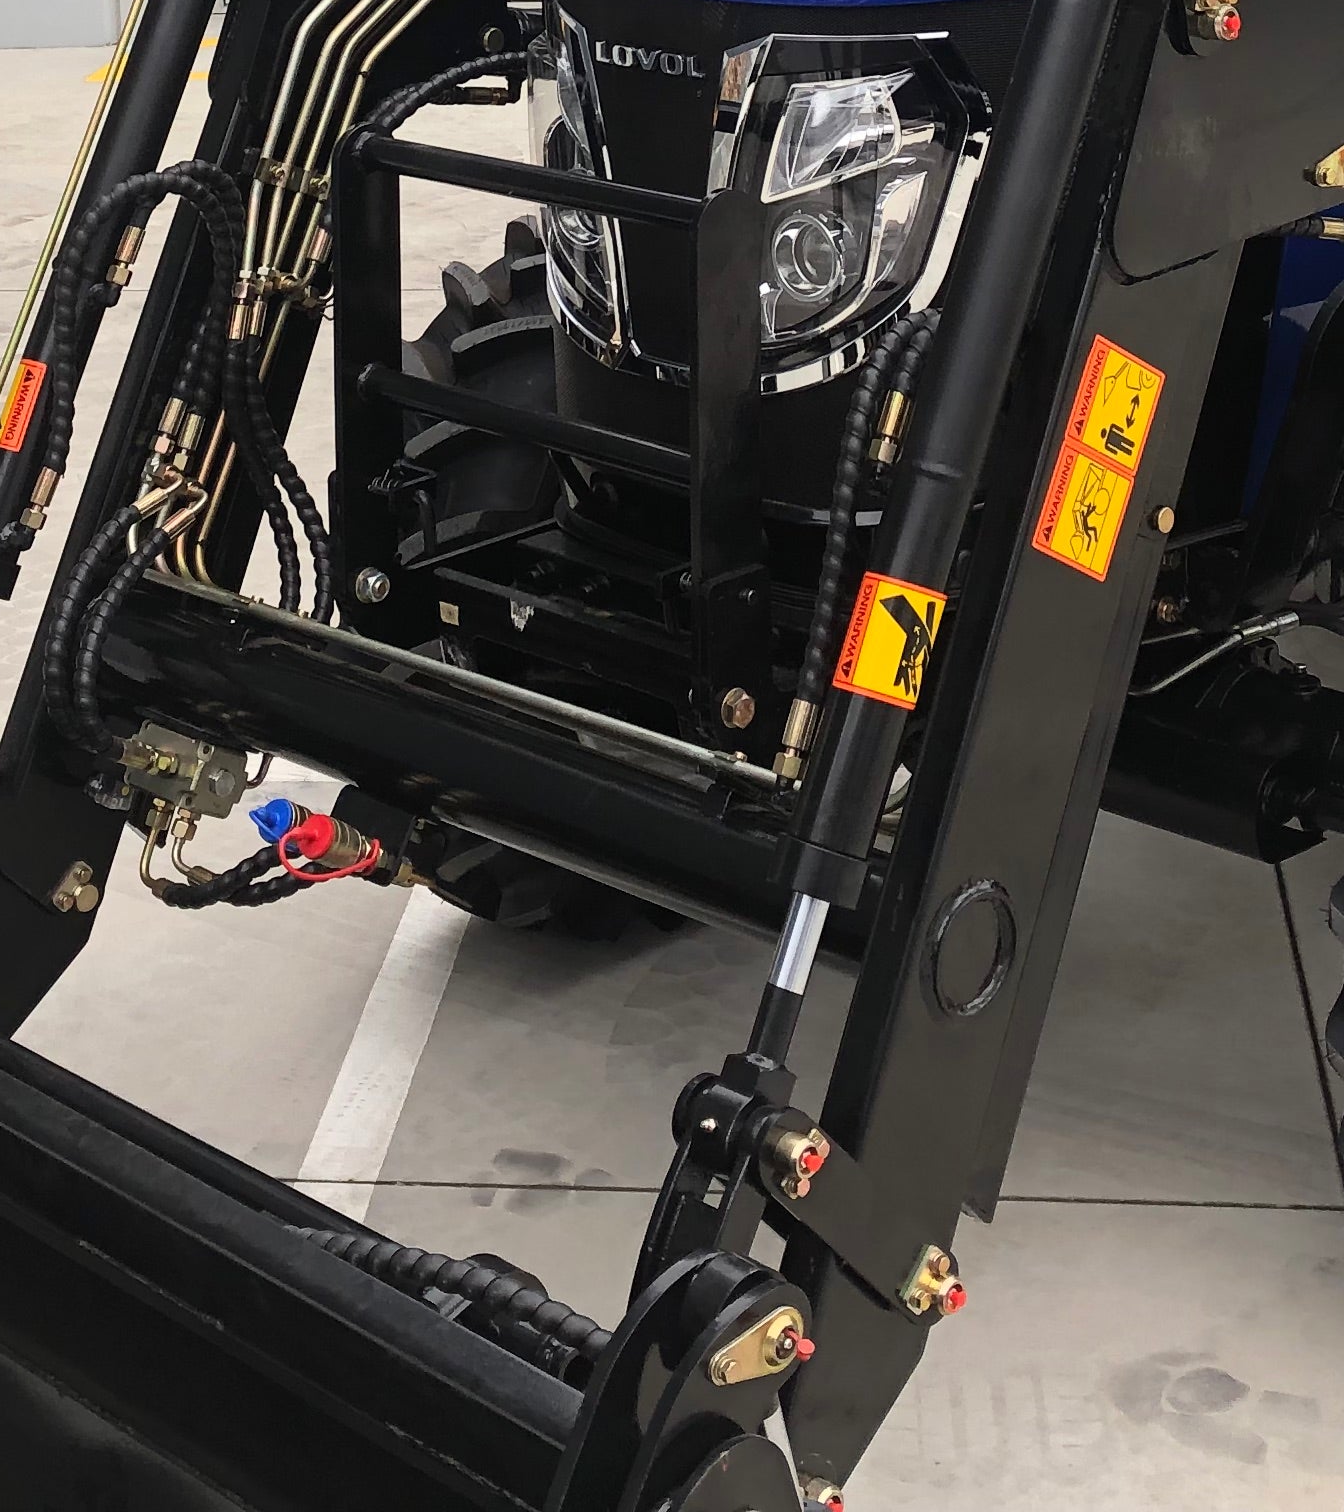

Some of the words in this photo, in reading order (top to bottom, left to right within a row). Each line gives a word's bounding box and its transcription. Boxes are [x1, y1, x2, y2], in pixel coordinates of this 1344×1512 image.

[595, 40, 706, 79] LOVOL
[4, 384, 31, 440] WARNING
[1079, 350, 1106, 417] WARNING
[1047, 454, 1074, 523] WARNING
[844, 584, 874, 658] WARNING
